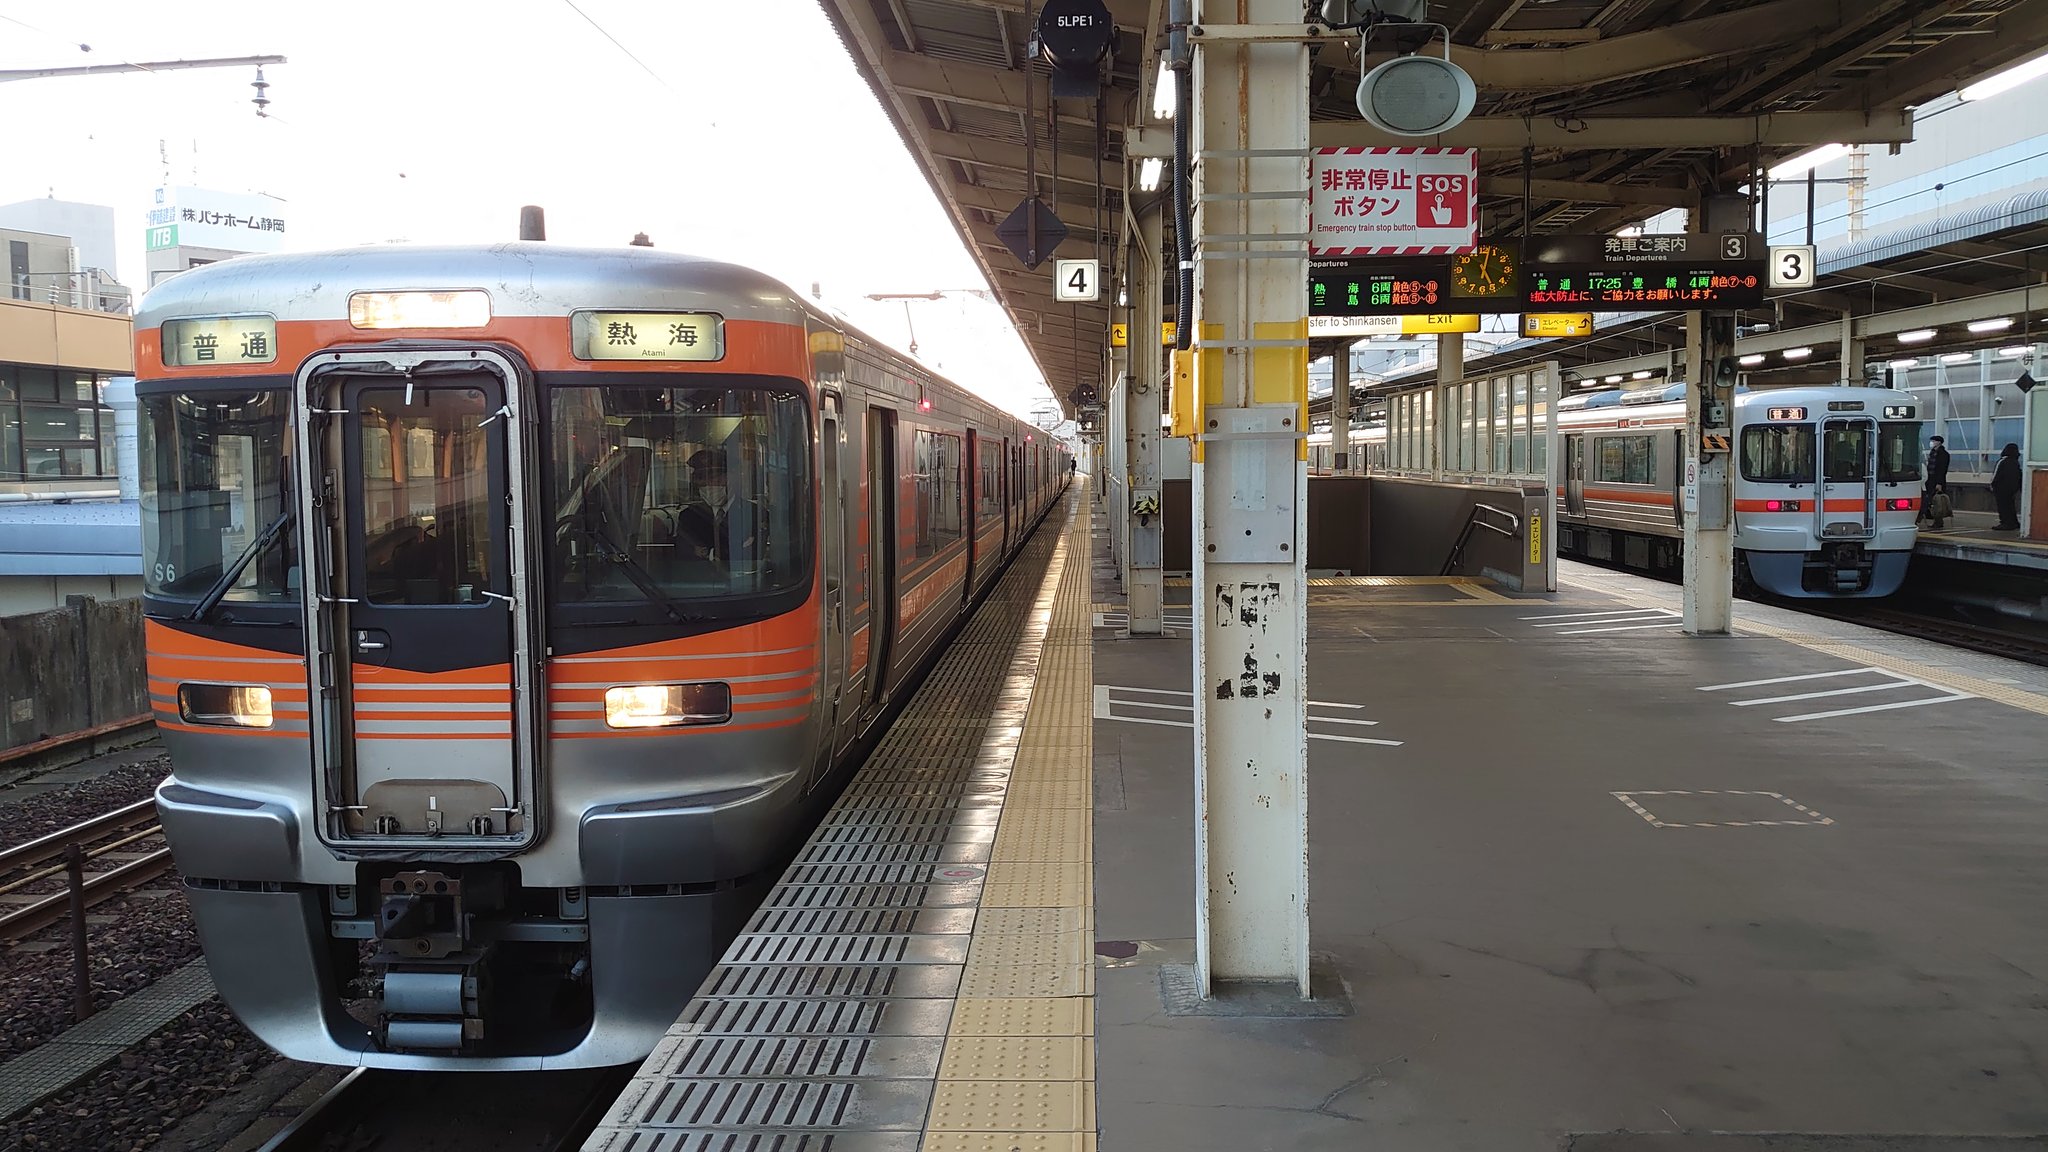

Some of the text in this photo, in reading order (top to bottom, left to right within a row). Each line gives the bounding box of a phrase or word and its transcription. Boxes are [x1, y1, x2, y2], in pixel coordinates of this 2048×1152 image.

[1057, 15, 1094, 27] 5LPE1
[1321, 168, 1412, 191] 非常停止
[1421, 176, 1463, 193] SOS
[1333, 195, 1401, 217] ボタン
[1317, 223, 1416, 234] Emergency train stop button
[1604, 237, 1687, 253] 発車ご案内
[1726, 237, 1741, 257] 3
[1309, 260, 1349, 269] Departures
[1604, 254, 1667, 263] Train Departures
[1782, 253, 1802, 280] 3
[1068, 267, 1087, 293] 4
[1588, 277, 1622, 289] 17:25
[1330, 316, 1340, 327] to
[1342, 316, 1398, 327] Shinkansen
[607, 321, 699, 347] 熱海
[192, 331, 269, 361] 普通
[641, 349, 666, 357] Atami
